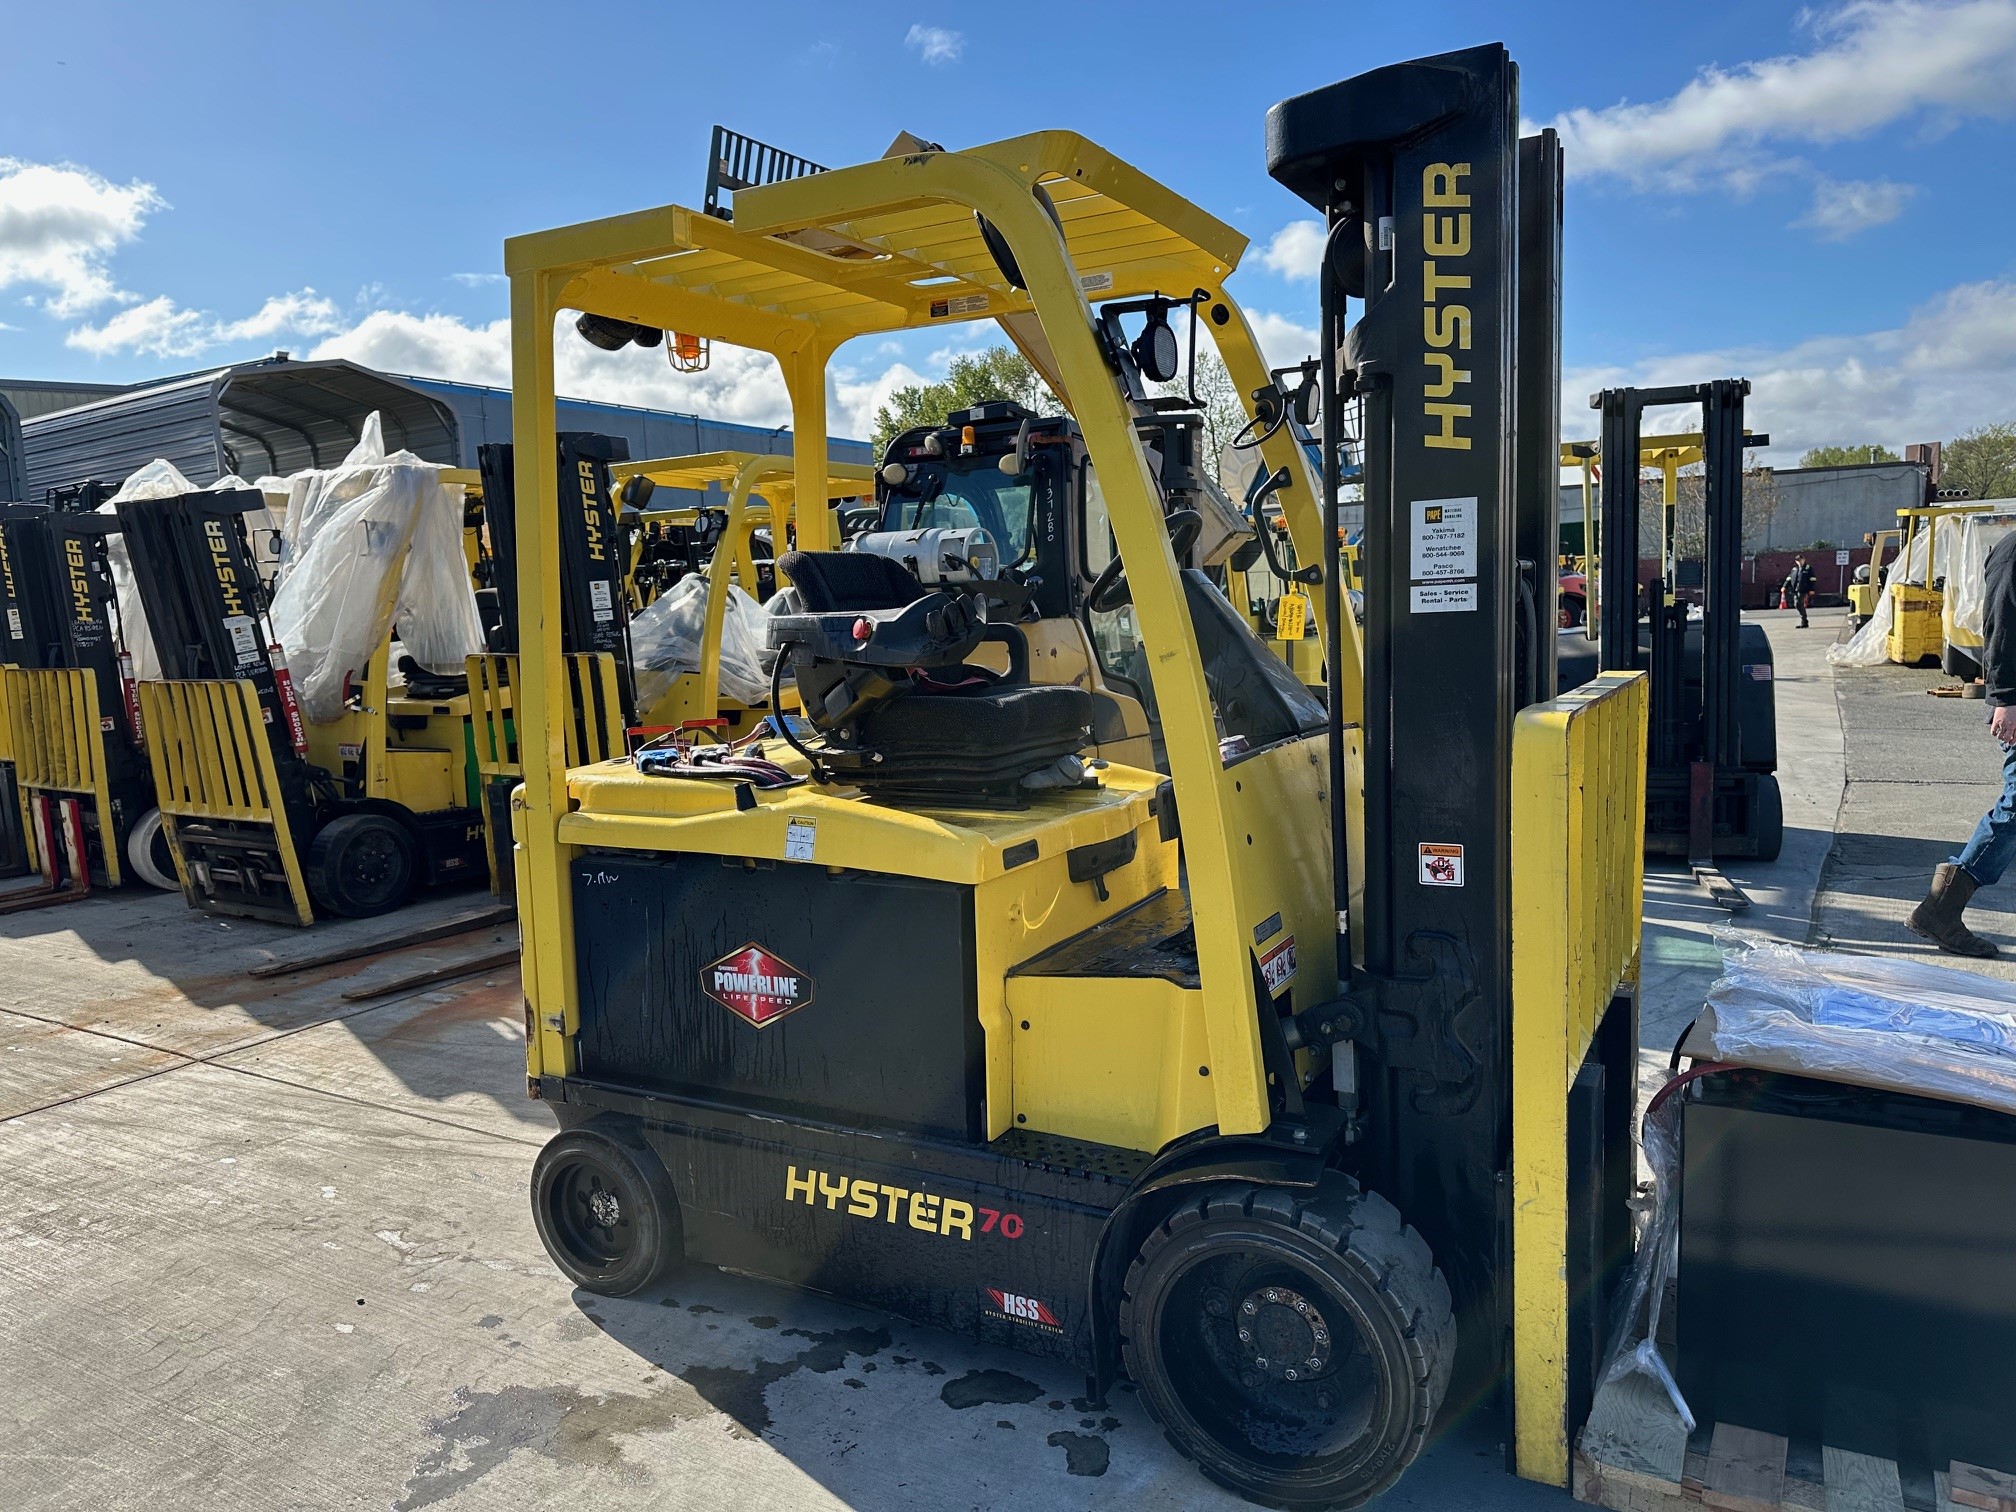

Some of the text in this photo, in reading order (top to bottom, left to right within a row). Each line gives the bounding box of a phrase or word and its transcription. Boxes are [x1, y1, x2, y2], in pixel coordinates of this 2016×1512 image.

[1423, 162, 1472, 450] HYSTER
[577, 460, 605, 561] HYSTER
[65, 539, 93, 622] HYSTER
[204, 520, 245, 616] HYSTER
[283, 680, 297, 707] HYDRA
[291, 711, 304, 742] SMOOTH
[713, 971, 799, 998] POWERLINE
[785, 1165, 1024, 1241] HYSTER 70
[985, 1310, 1064, 1335] HYSTER STABILITY SYSTEM
[1003, 1292, 1039, 1320] HSS
